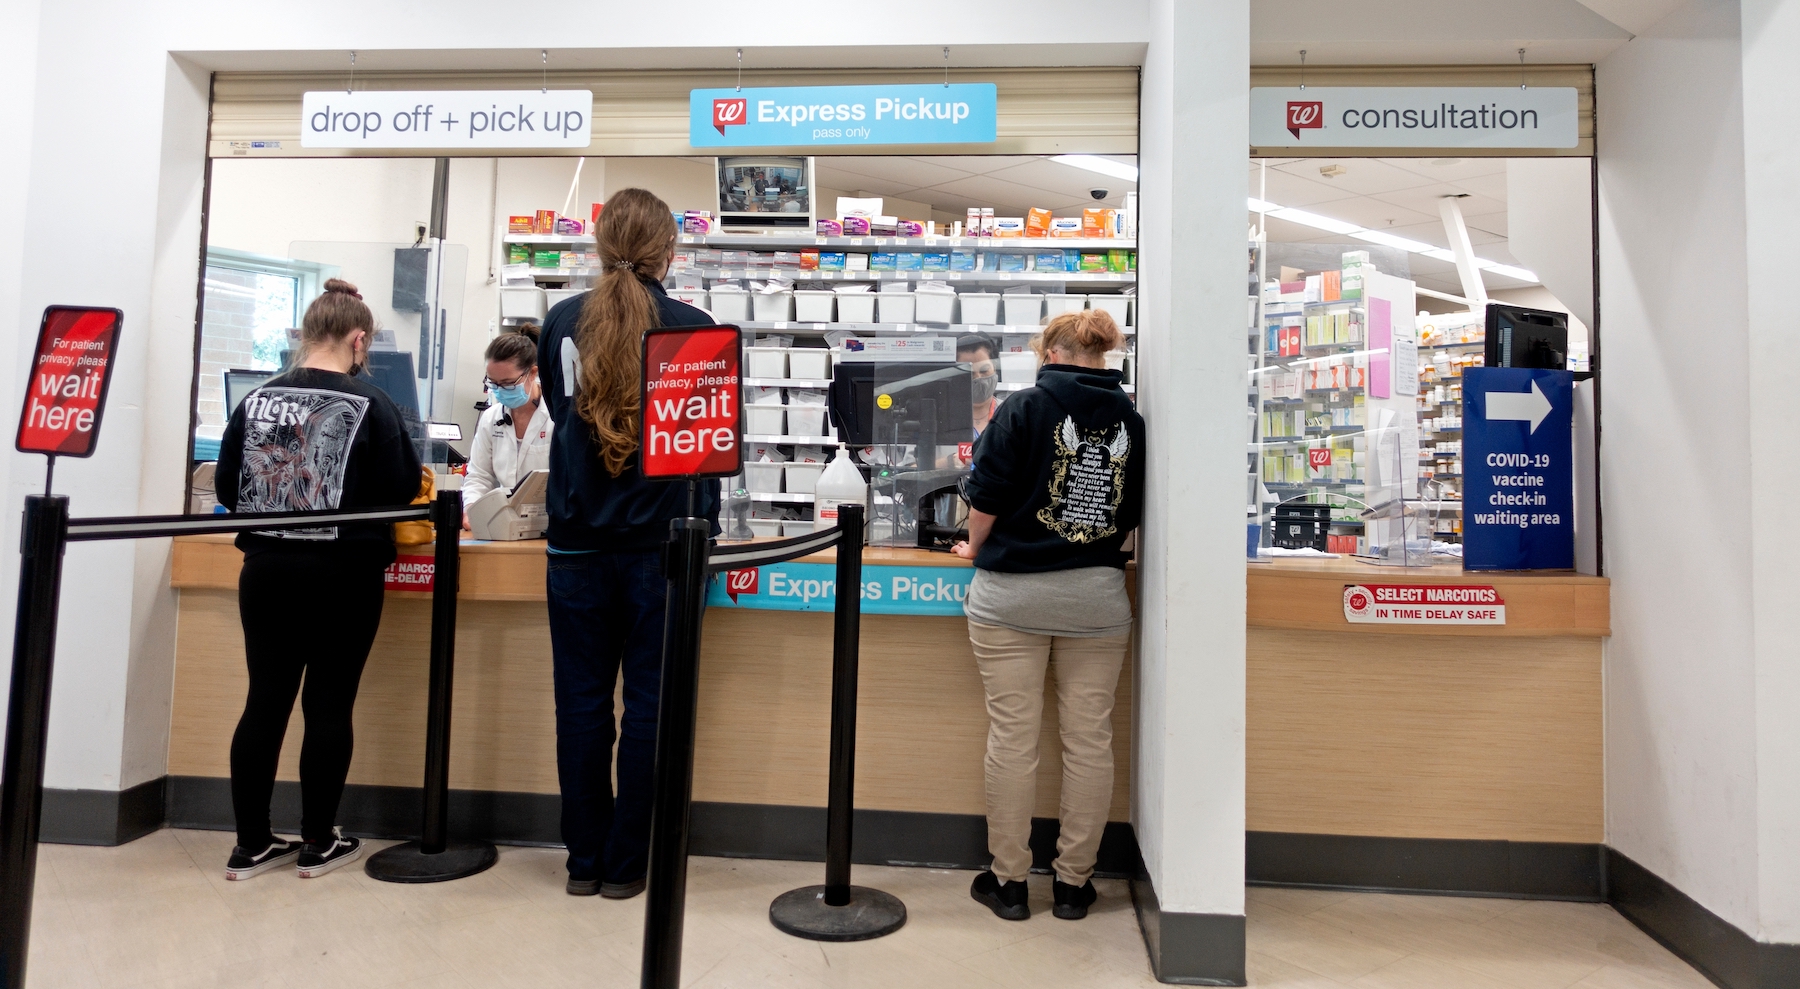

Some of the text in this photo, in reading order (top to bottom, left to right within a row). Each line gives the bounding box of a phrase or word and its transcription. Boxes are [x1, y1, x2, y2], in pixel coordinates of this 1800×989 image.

[757, 97, 970, 126] Express Pickup
[1342, 103, 1539, 130] consultation
[310, 103, 583, 139] drop off + pick up
[812, 126, 871, 140] pass only
[53, 338, 104, 351] For patient
[39, 353, 75, 366] privacy,
[659, 359, 726, 374] For patient
[41, 369, 100, 399] wait
[647, 375, 738, 392] privacy, please
[653, 388, 731, 421] wait
[28, 398, 95, 432] here
[649, 424, 735, 456] here
[1089, 446, 1100, 454] think
[1082, 458, 1102, 469] always
[1486, 453, 1550, 467] COVID-19
[1075, 473, 1104, 486] forgotten
[1492, 471, 1544, 486] vaccine
[1489, 491, 1546, 506] check-in
[1062, 509, 1088, 518] throughout
[1474, 510, 1560, 528] waiting area
[384, 573, 432, 584] E-DELAY
[769, 572, 882, 603] Exprs
[1376, 588, 1496, 602] SELECT NARCOTICS
[1376, 609, 1496, 619] IN TIME DELAY SAFE
